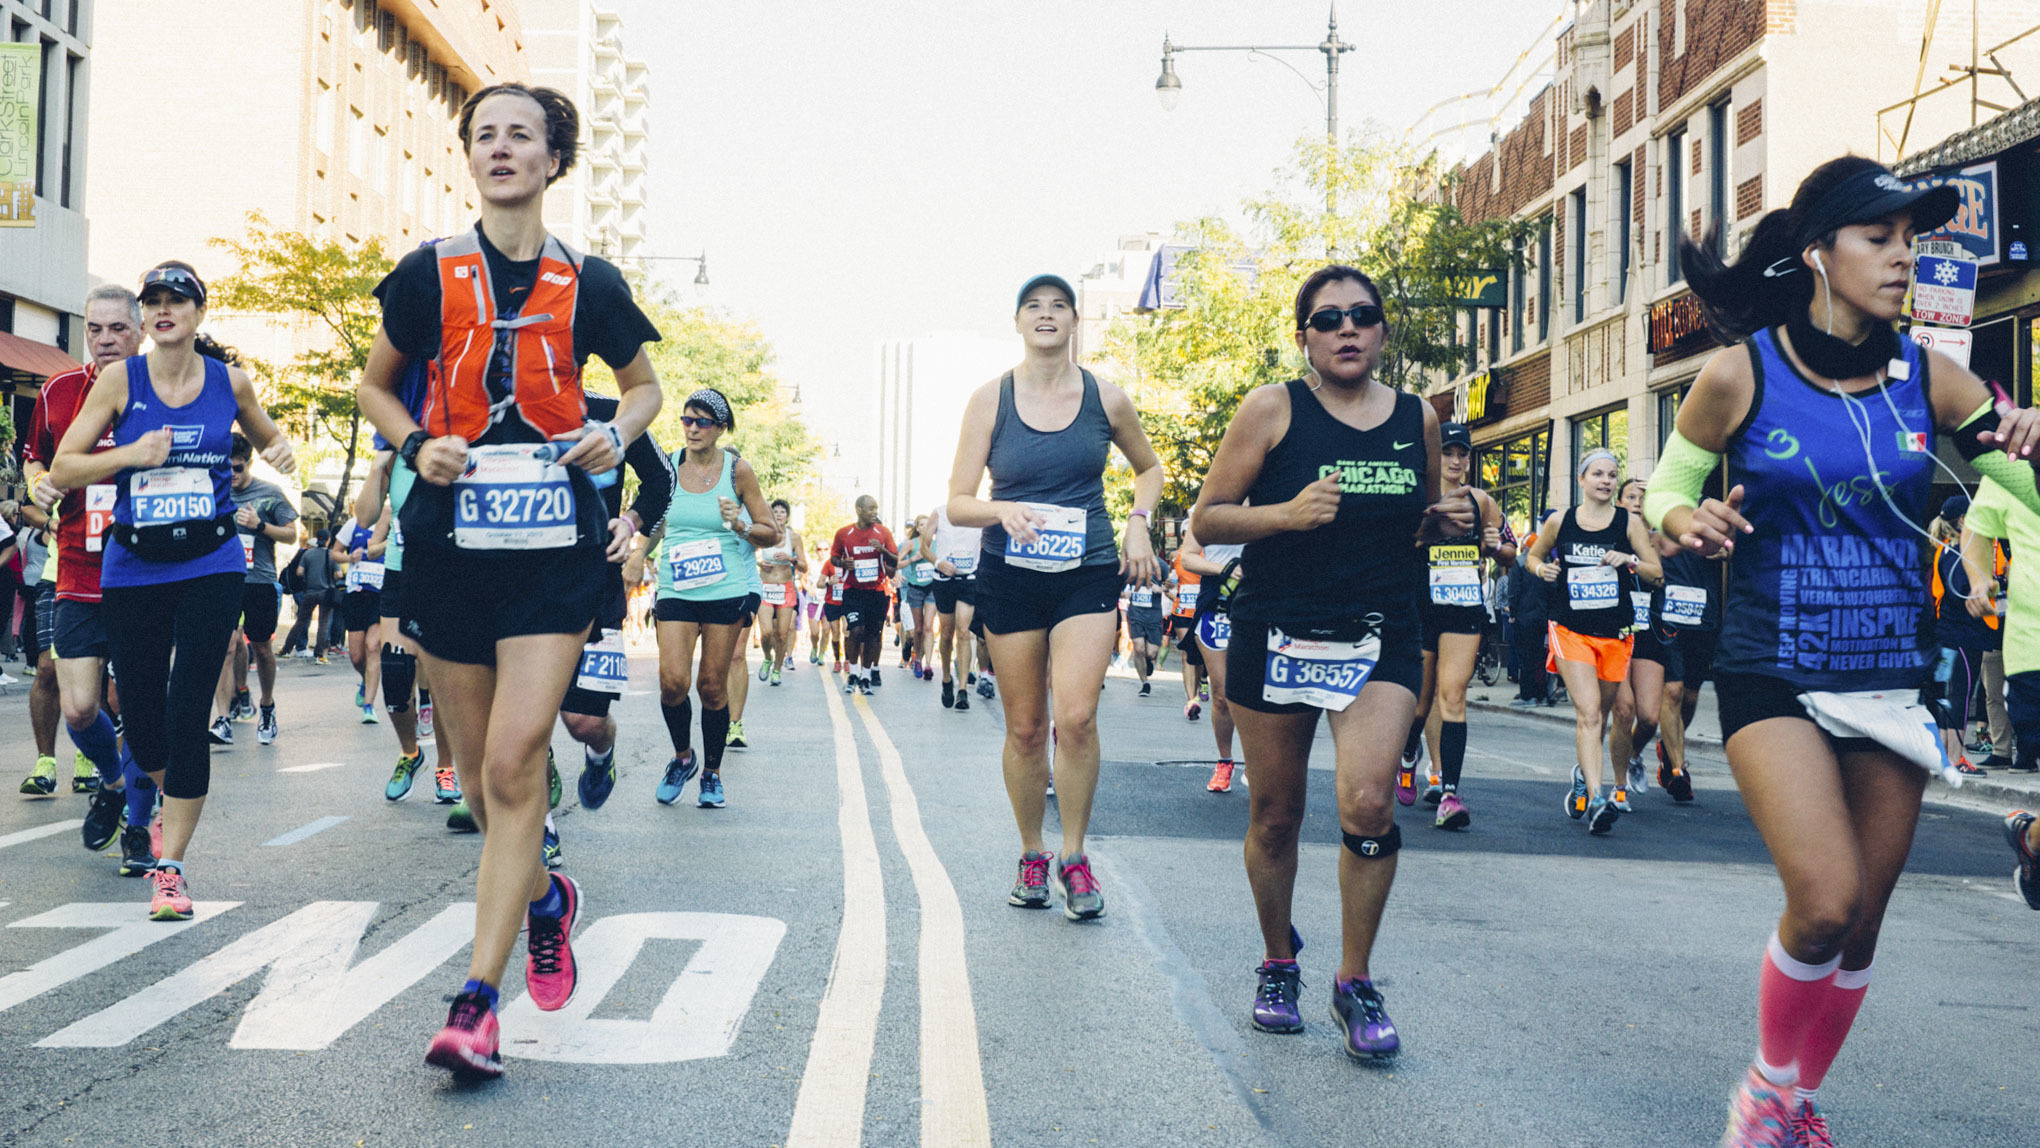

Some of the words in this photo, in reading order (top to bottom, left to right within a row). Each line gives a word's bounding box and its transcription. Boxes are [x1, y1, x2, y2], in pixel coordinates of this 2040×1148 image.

[1917, 243, 1929, 254] ARY
[1930, 242, 1954, 255] BRUNCH
[1915, 310, 1935, 320] TOW
[1940, 313, 1965, 324] ZONE
[1451, 371, 1490, 424] SUBWAY
[166, 452, 227, 464] miNation
[1319, 465, 1417, 486] CHICAGO
[136, 497, 147, 519] F
[153, 496, 212, 518] 20150
[460, 489, 479, 522] G
[485, 486, 571, 523] 32720
[90, 512, 103, 535] D
[1434, 547, 1476, 560] Jennie
[1572, 543, 1606, 557] Katie
[674, 564, 683, 579] F
[684, 557, 723, 577] 29229
[1433, 587, 1441, 601] G
[1444, 586, 1479, 601] 30403
[1570, 584, 1579, 598] G
[1581, 583, 1618, 598] 34326
[1779, 568, 1798, 629] MOVING
[1218, 624, 1226, 637] F
[584, 654, 597, 673] F
[1829, 654, 1875, 670] NEVER
[1271, 655, 1288, 682] G
[1295, 660, 1371, 689] 36557
